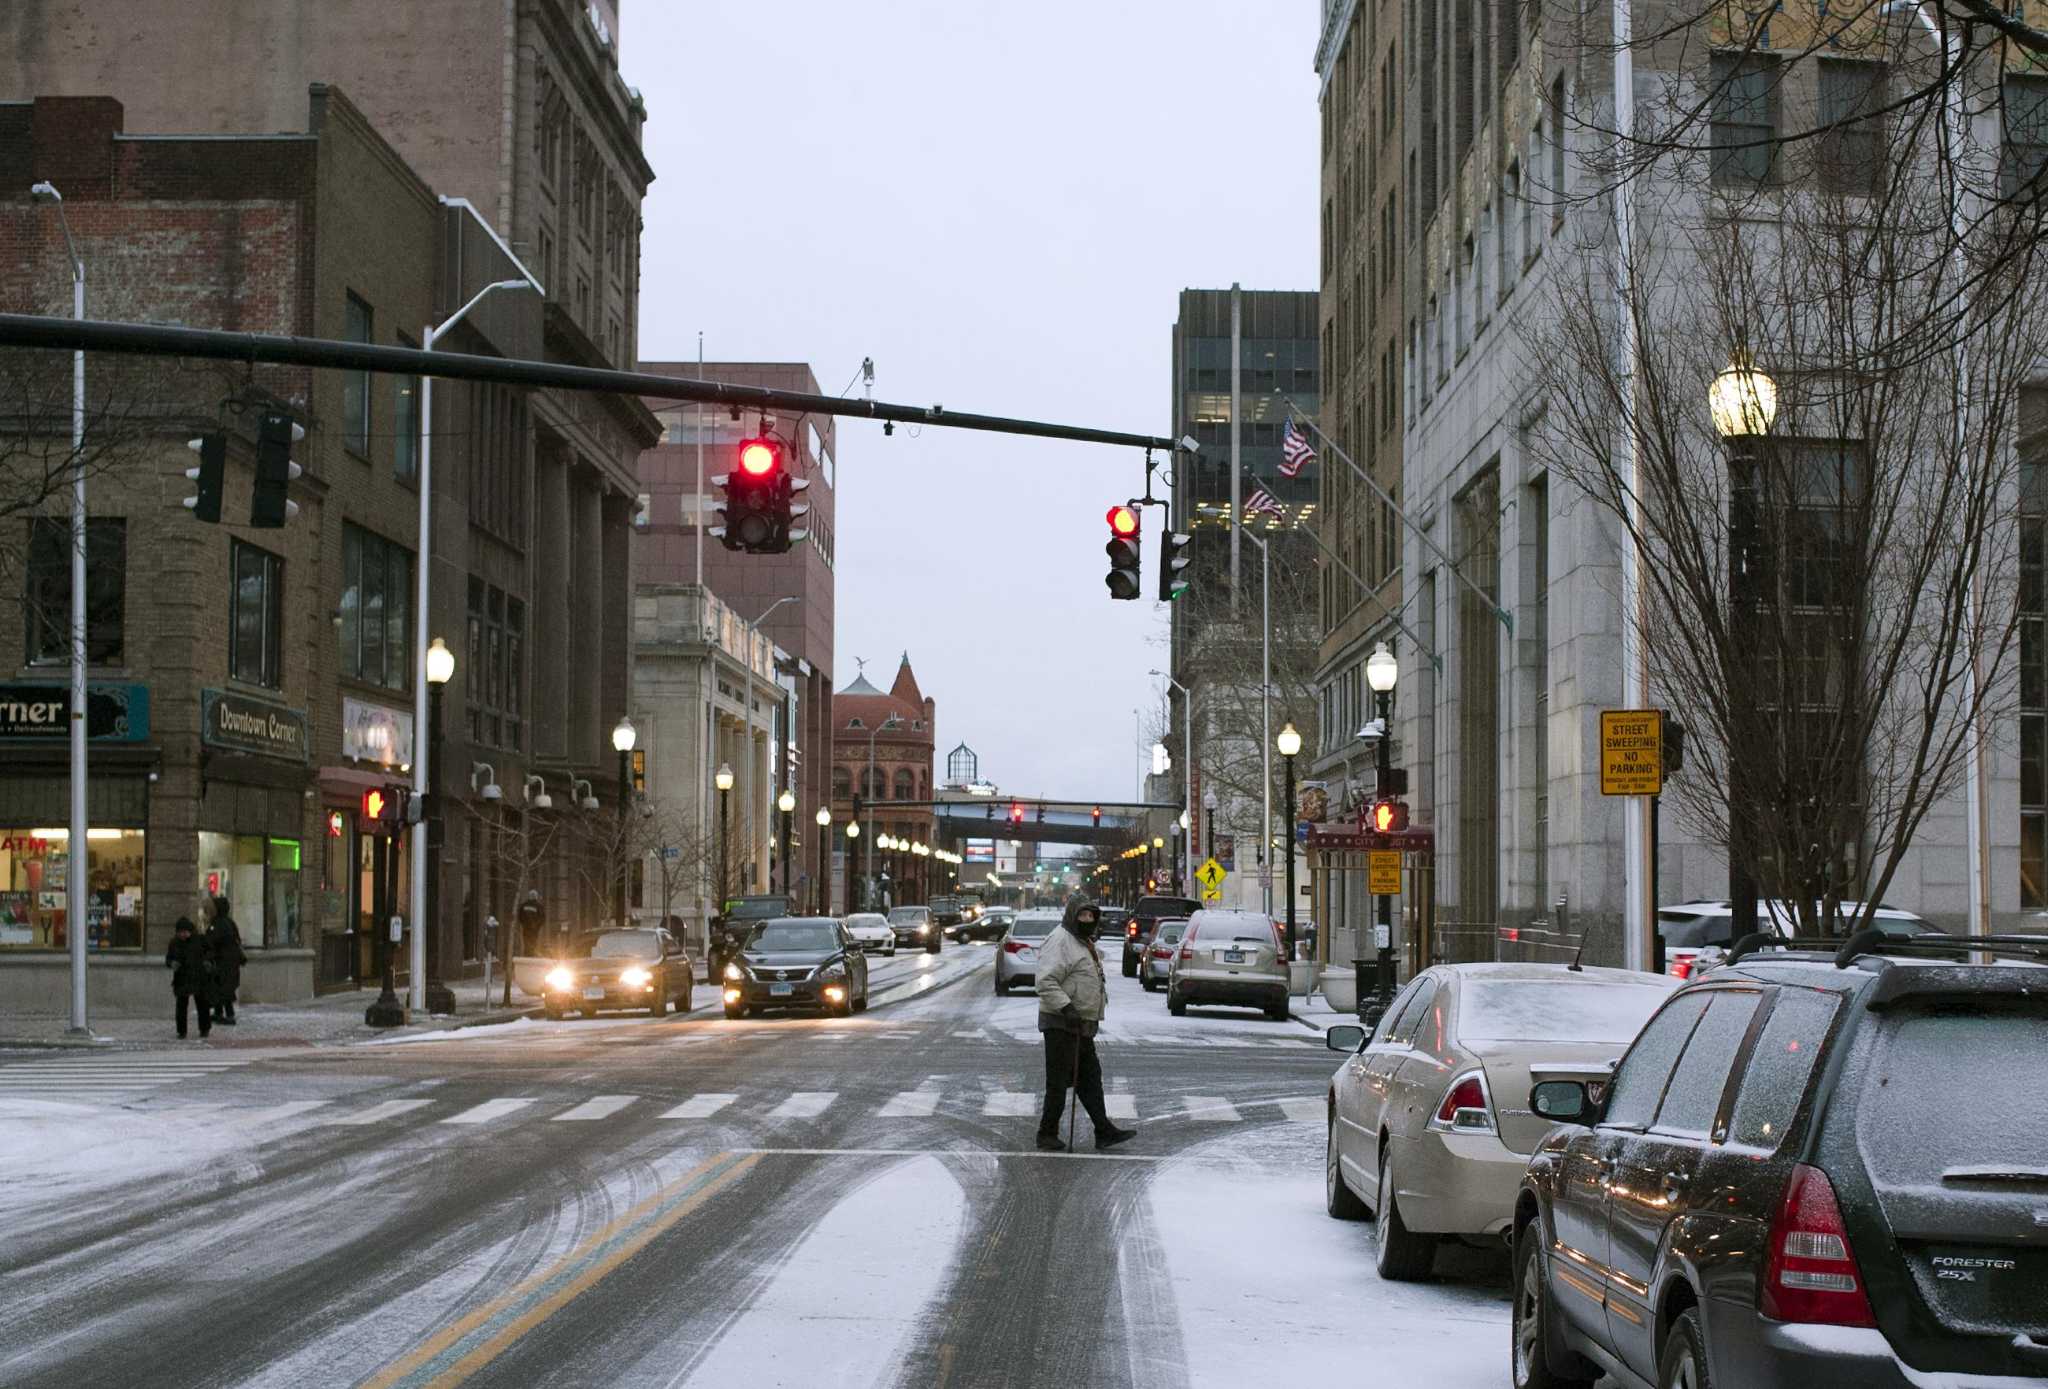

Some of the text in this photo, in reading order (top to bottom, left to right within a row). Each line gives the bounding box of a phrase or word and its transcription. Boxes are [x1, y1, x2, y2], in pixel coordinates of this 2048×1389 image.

[221, 703, 296, 742] Downtown Corner
[1613, 724, 1648, 735] STREET
[1606, 737, 1656, 747] SWEEPING
[1624, 752, 1638, 761] NO
[1610, 763, 1652, 774] PARKING
[1, 836, 48, 850] ATM
[1354, 838, 1375, 846] CITY
[1932, 1256, 2016, 1269] FORESTER
